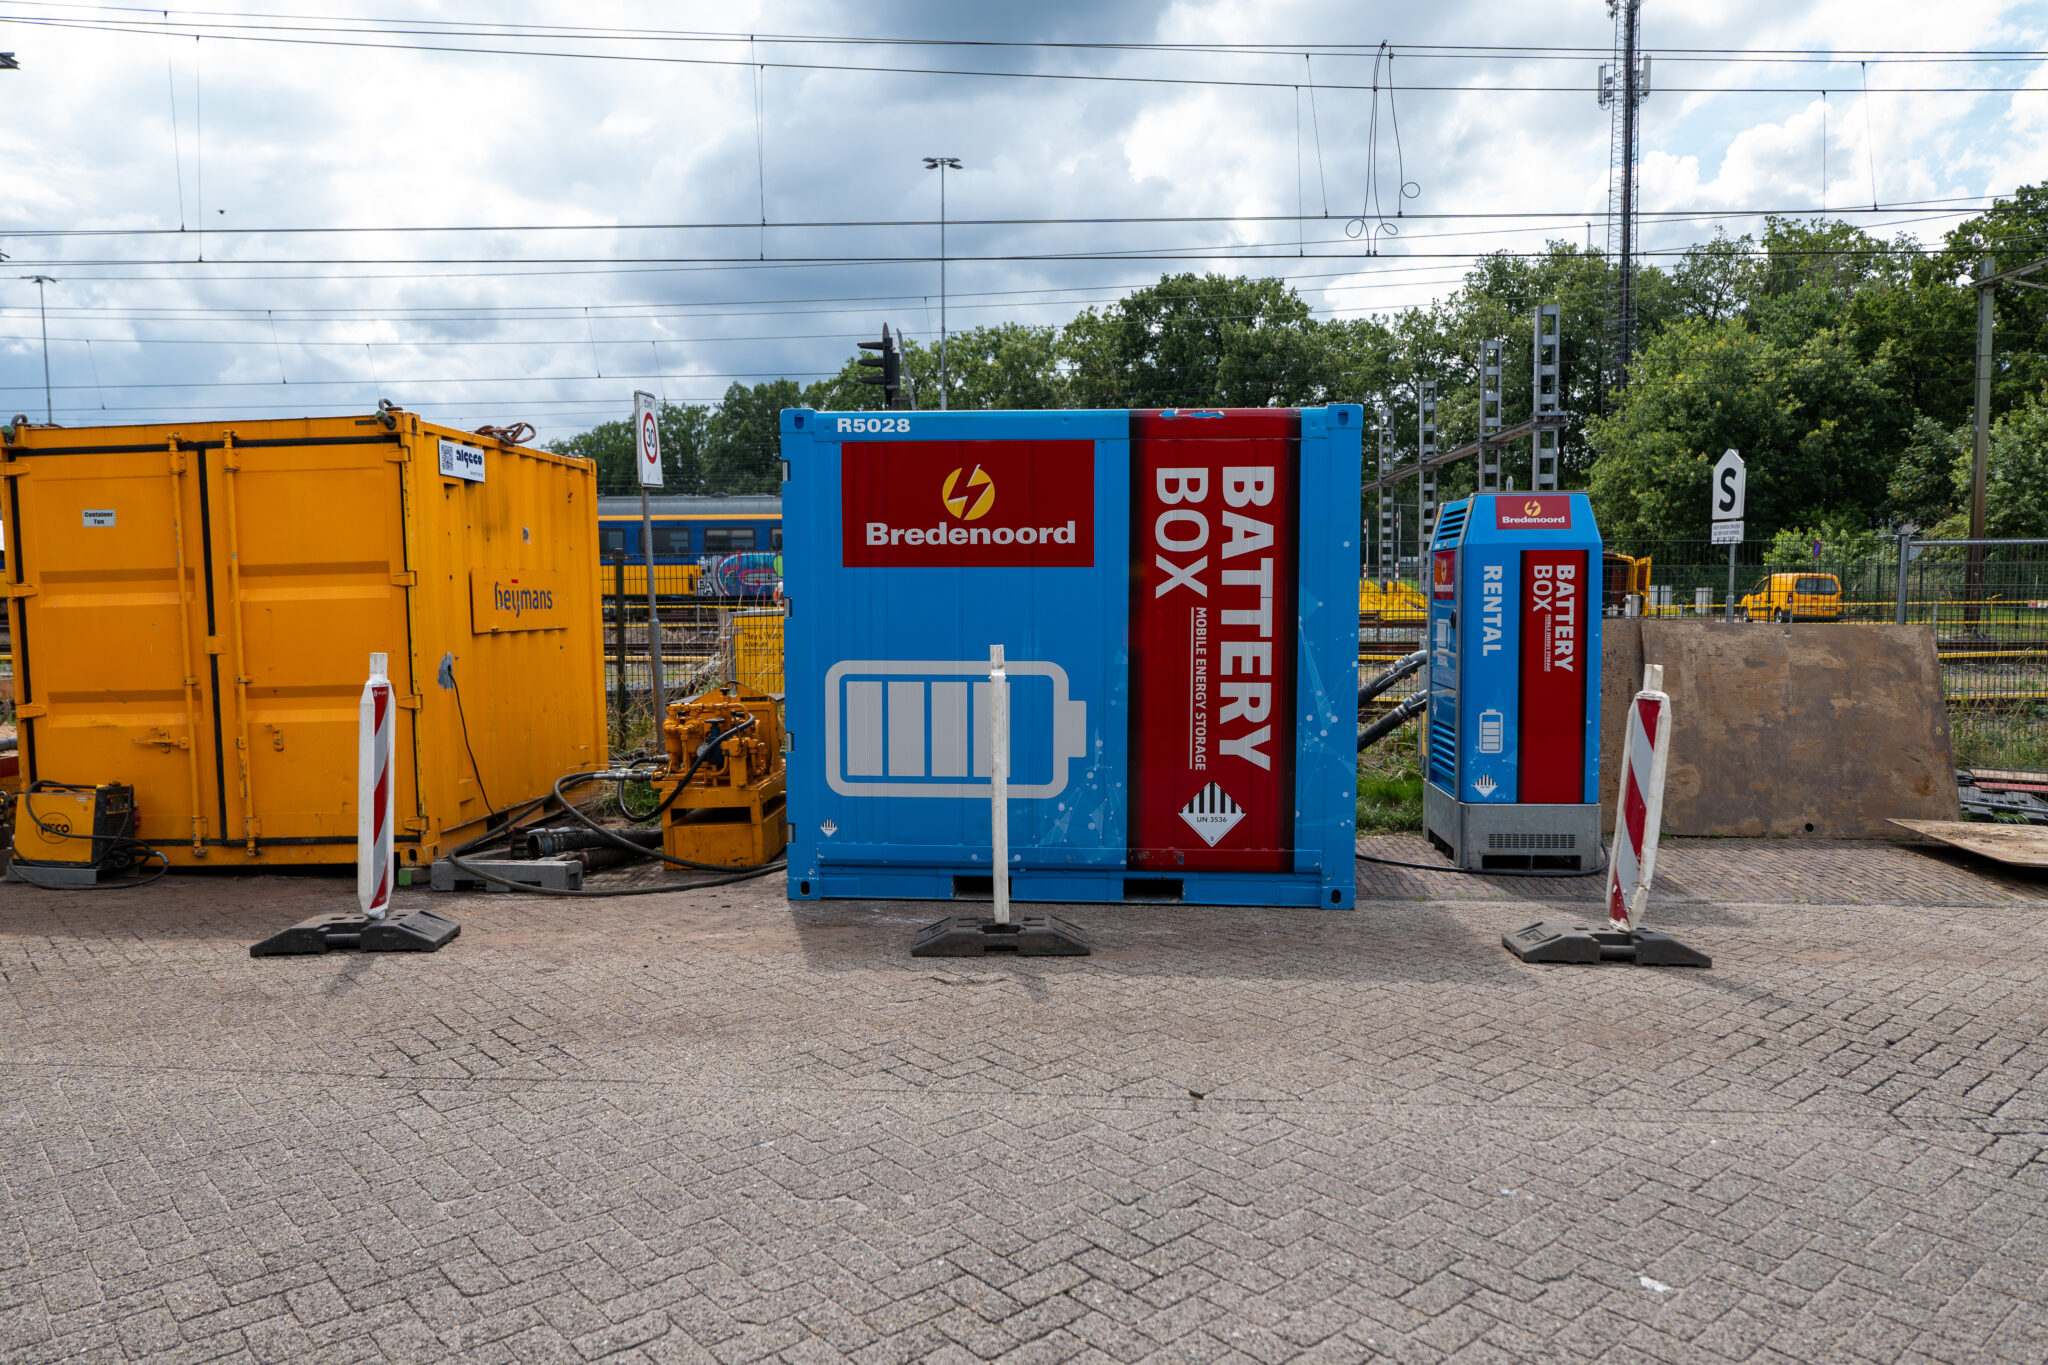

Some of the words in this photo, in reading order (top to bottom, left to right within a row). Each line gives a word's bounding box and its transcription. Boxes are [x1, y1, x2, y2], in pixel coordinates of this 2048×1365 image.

[646, 427, 655, 448] 30
[837, 418, 911, 433] R5028
[1718, 467, 1737, 512] S
[866, 520, 1075, 545] Bredenoord
[1154, 467, 1210, 600] BOX
[1502, 515, 1566, 524] Bredenoord
[1482, 565, 1503, 657] RENTAL
[1533, 565, 1553, 613] BOX
[1195, 606, 1208, 655] MOBILE
[1219, 466, 1274, 771] BATTERY
[1554, 564, 1576, 673] BATTERY
[1195, 658, 1207, 710] ENERGY
[1195, 712, 1207, 771] STORAGE
